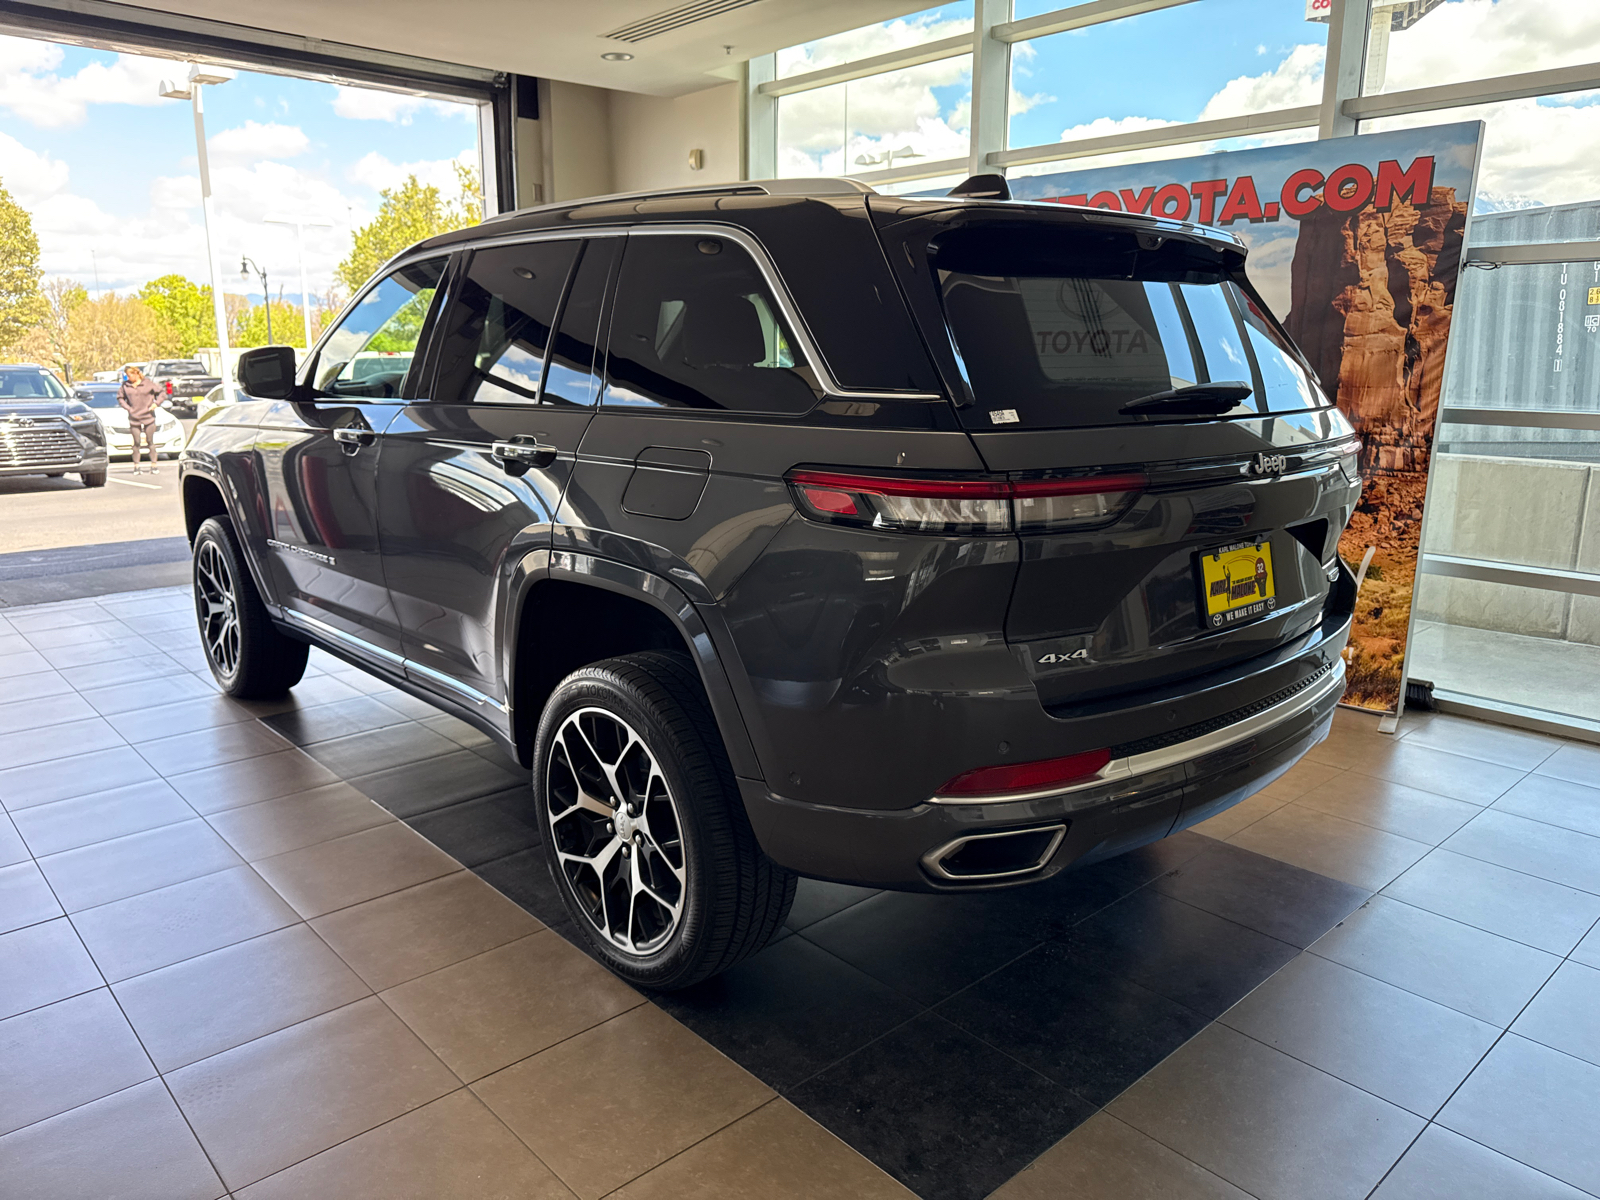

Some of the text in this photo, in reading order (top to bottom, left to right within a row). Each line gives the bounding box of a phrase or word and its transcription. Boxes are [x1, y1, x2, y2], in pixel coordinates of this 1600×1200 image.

[1032, 155, 1435, 226] OYOTA.COM
[1037, 329, 1148, 354] TOYOTA
[1255, 453, 1286, 474] Jeep
[1257, 563, 1264, 574] 32
[1226, 602, 1264, 621] WE MAKE IT EASY
[1038, 649, 1088, 663] 4x4
